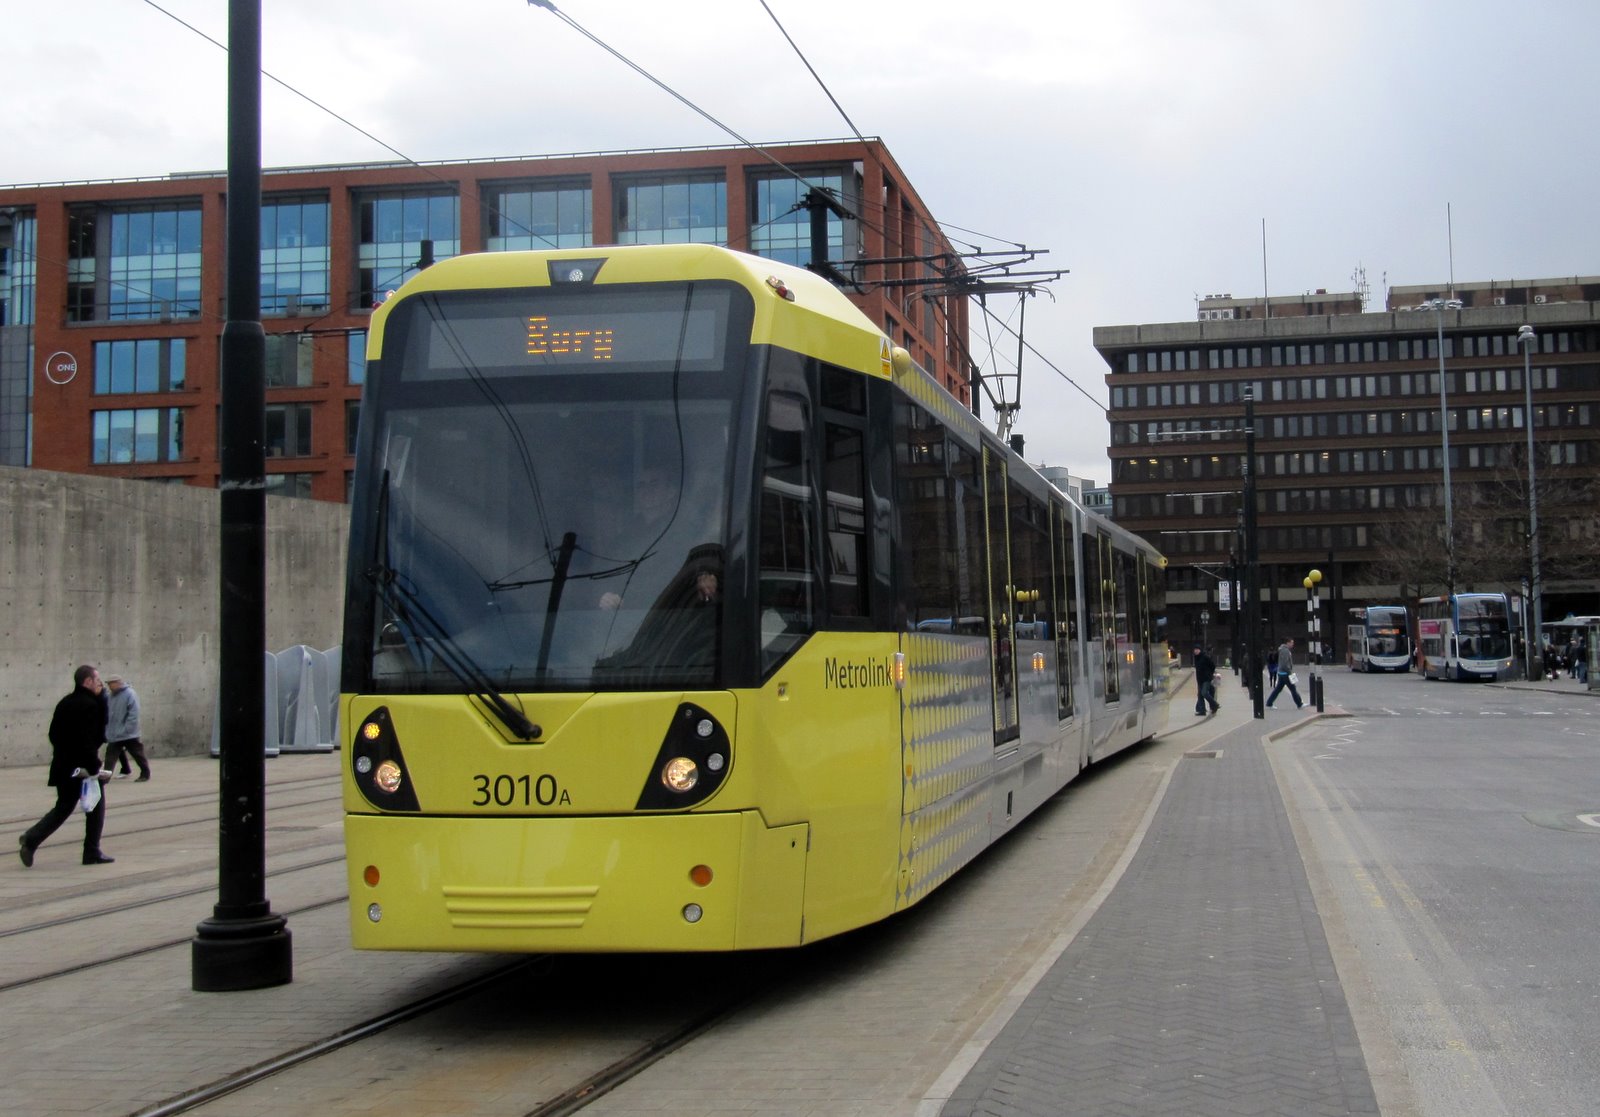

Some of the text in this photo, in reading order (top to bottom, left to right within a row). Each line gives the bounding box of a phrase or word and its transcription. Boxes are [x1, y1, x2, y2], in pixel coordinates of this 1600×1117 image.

[527, 316, 613, 359] Bury
[57, 363, 76, 372] ONE
[825, 656, 893, 689] Metrolink
